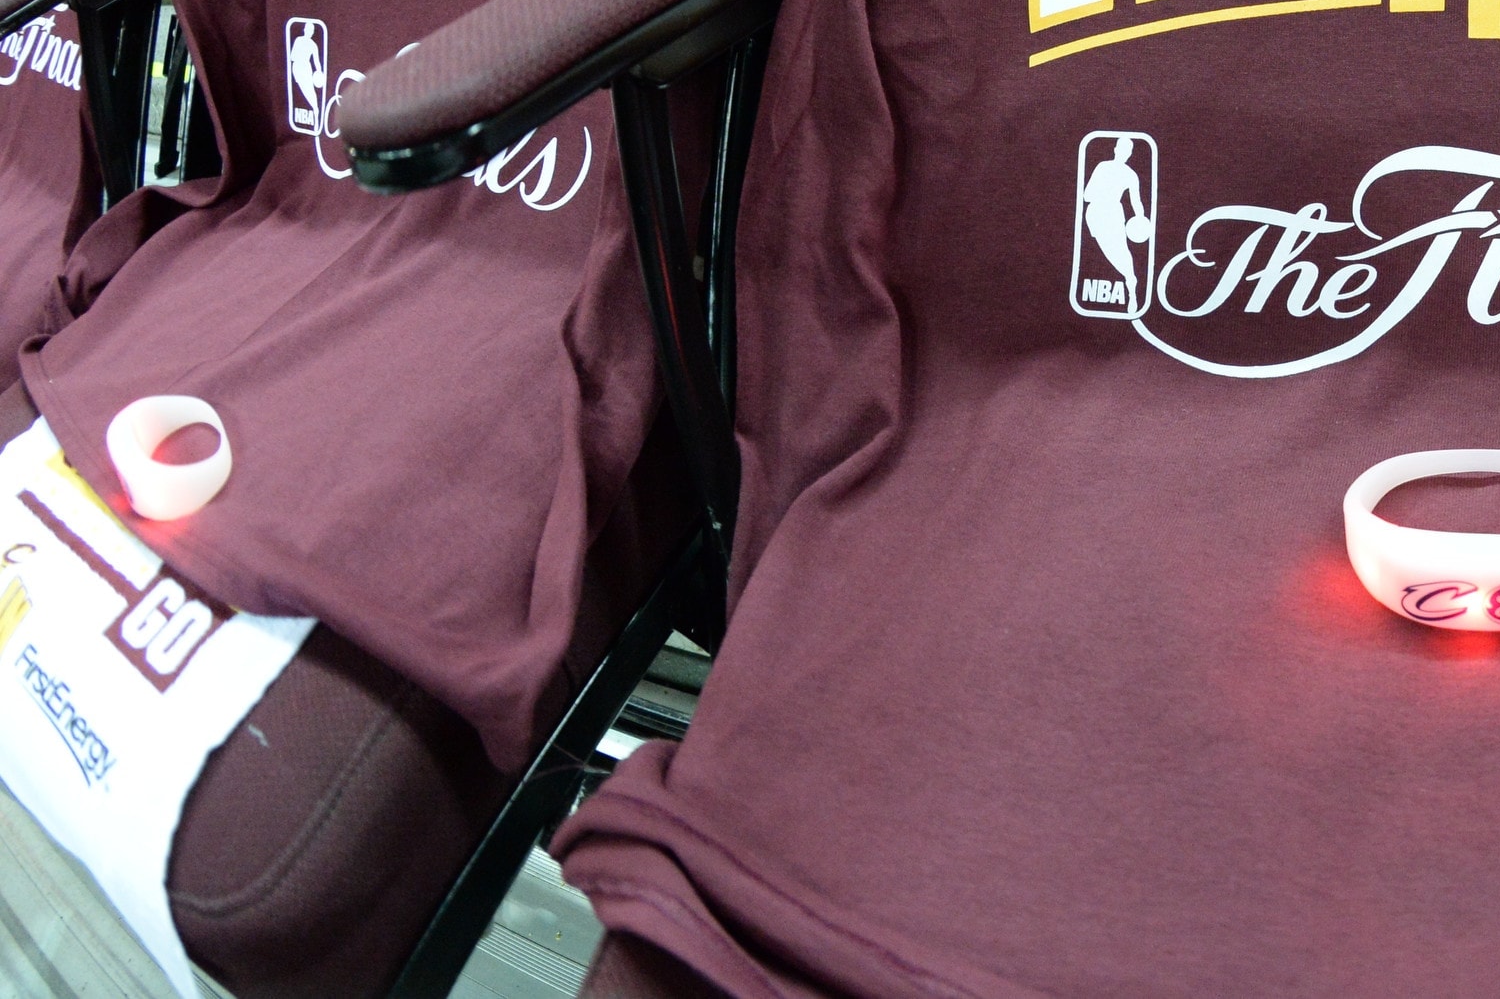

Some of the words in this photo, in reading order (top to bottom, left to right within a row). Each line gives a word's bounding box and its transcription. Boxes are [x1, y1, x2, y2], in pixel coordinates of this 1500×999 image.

[1082, 279, 1126, 305] NBA
[1157, 203, 1378, 320] The
[121, 577, 212, 676] GO
[14, 643, 117, 781] FirstEnergy
